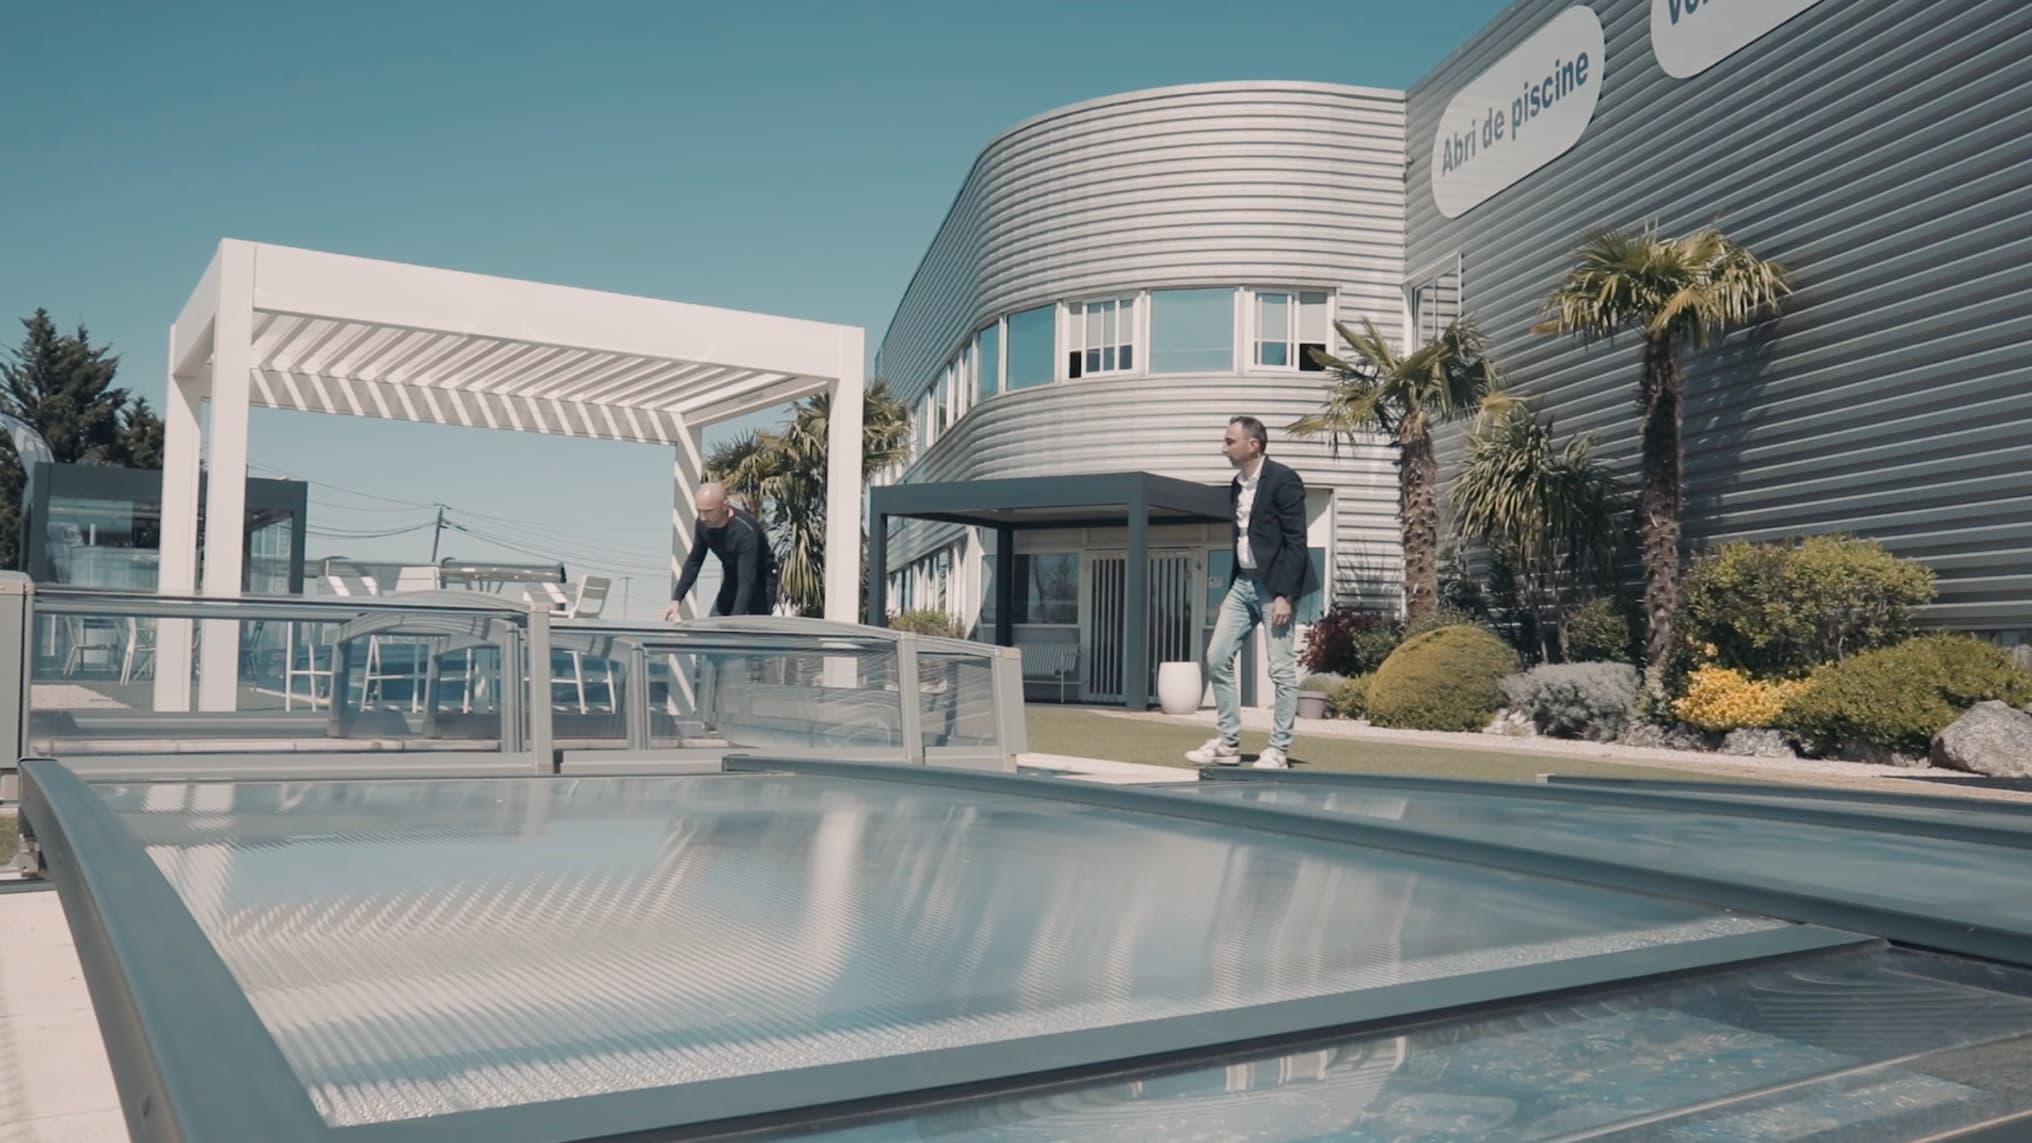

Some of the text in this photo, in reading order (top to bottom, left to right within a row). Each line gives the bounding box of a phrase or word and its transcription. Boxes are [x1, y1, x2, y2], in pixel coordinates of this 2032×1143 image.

[1441, 51, 1589, 177] Abri de piscine
